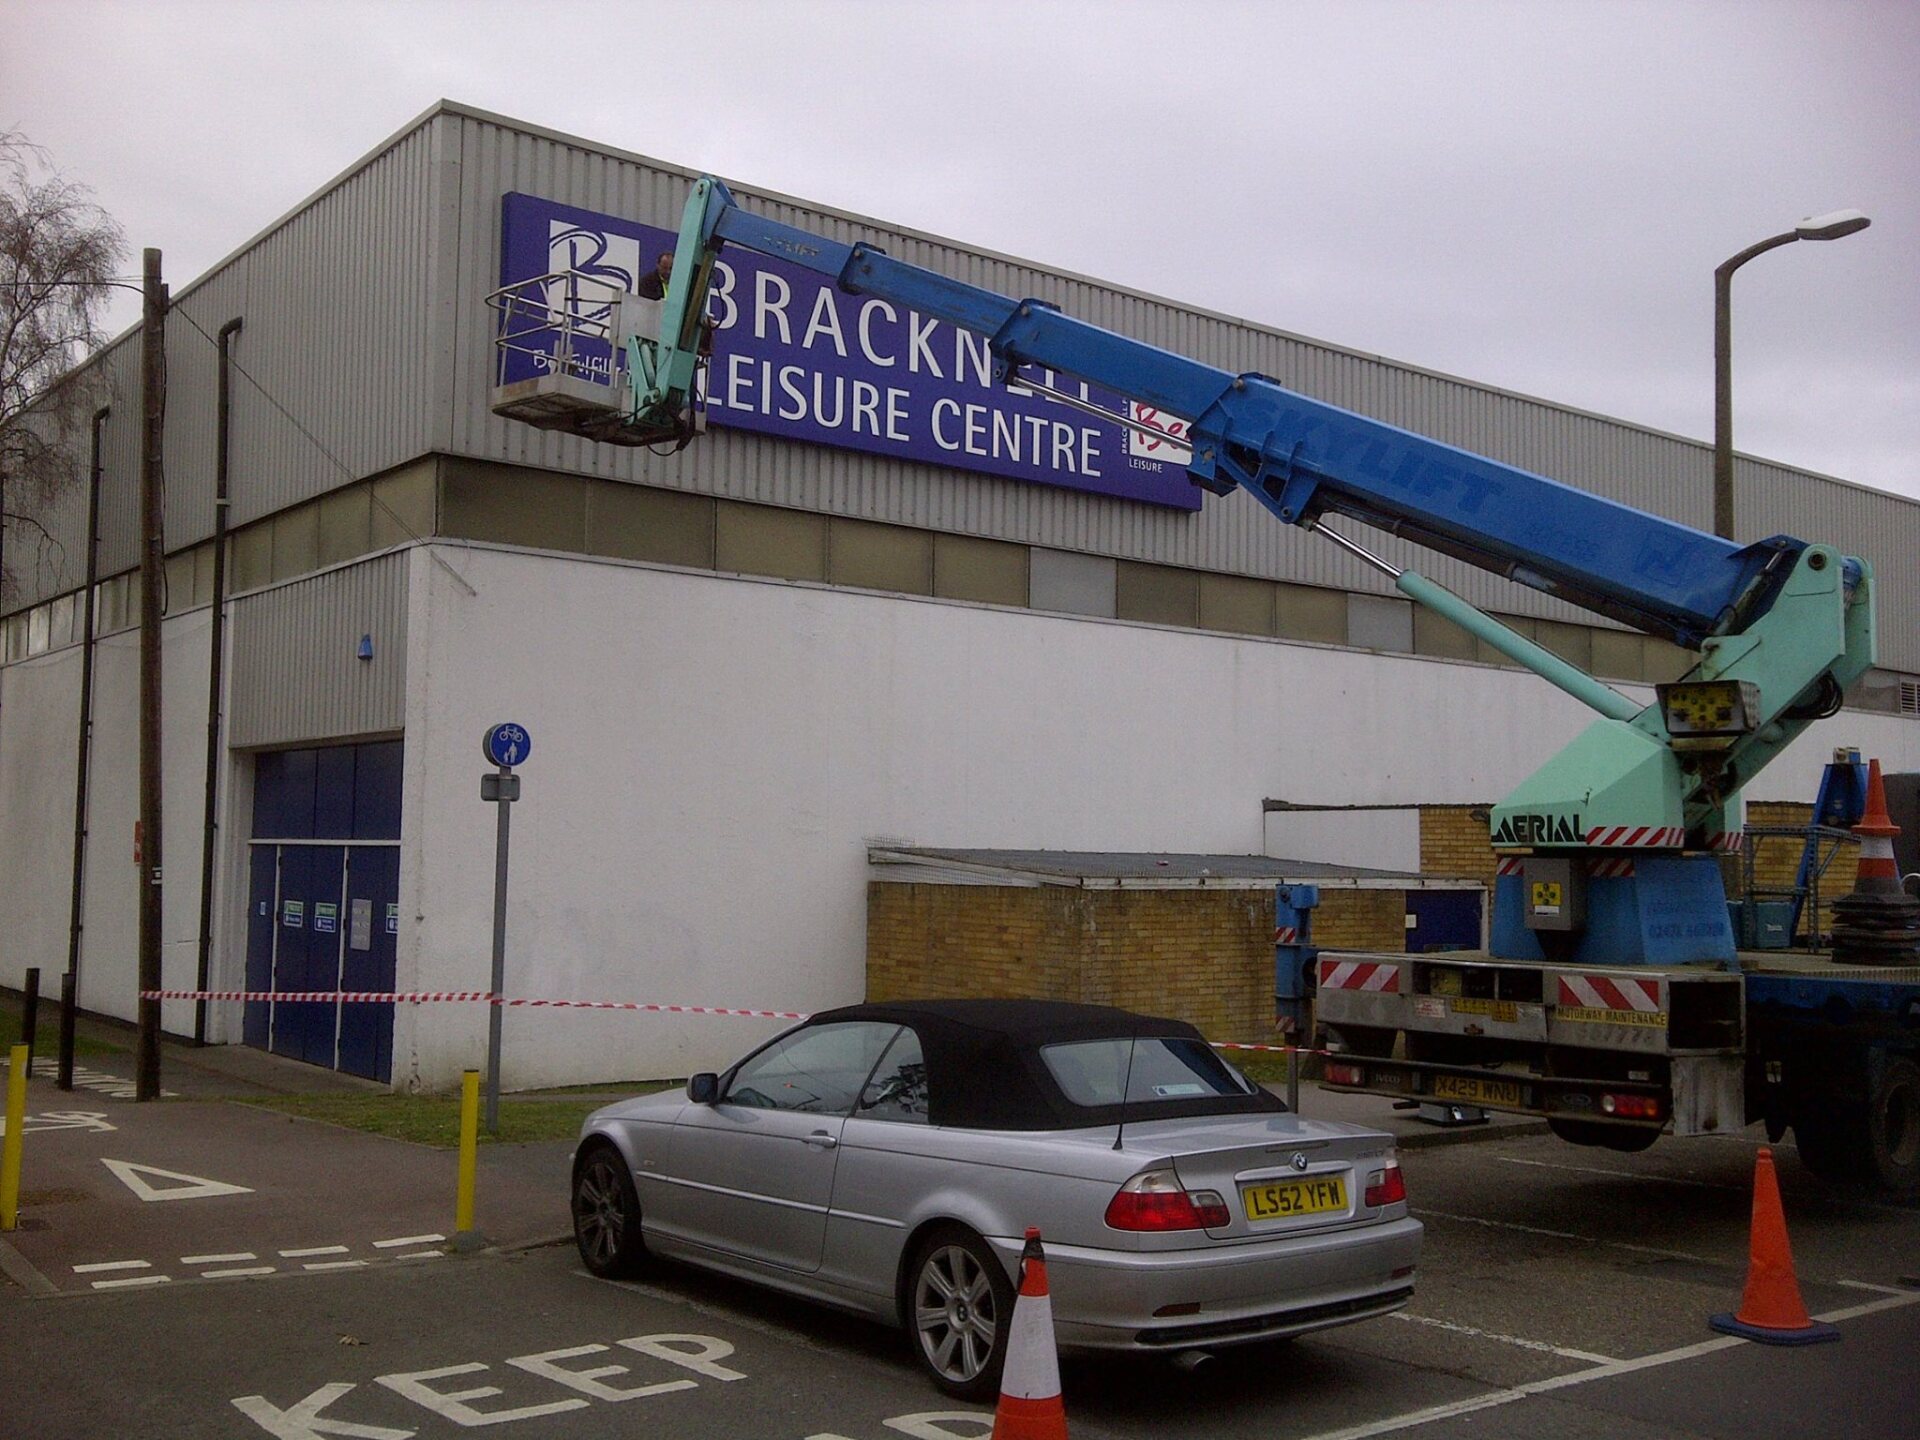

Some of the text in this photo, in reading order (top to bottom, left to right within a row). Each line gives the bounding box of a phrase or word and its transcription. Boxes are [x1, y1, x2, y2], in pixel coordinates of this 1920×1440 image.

[706, 260, 1104, 408] BRACKN
[697, 354, 1101, 477] LEISURE CENTRE
[1128, 458, 1163, 473] LEISURE
[1491, 814, 1586, 842] AERIAL
[1557, 1007, 1666, 1026] MOTORWAY MAINTENANCE
[1437, 1076, 1478, 1096] X429
[1252, 1185, 1303, 1216] LS52
[231, 1333, 747, 1440] KEEP
